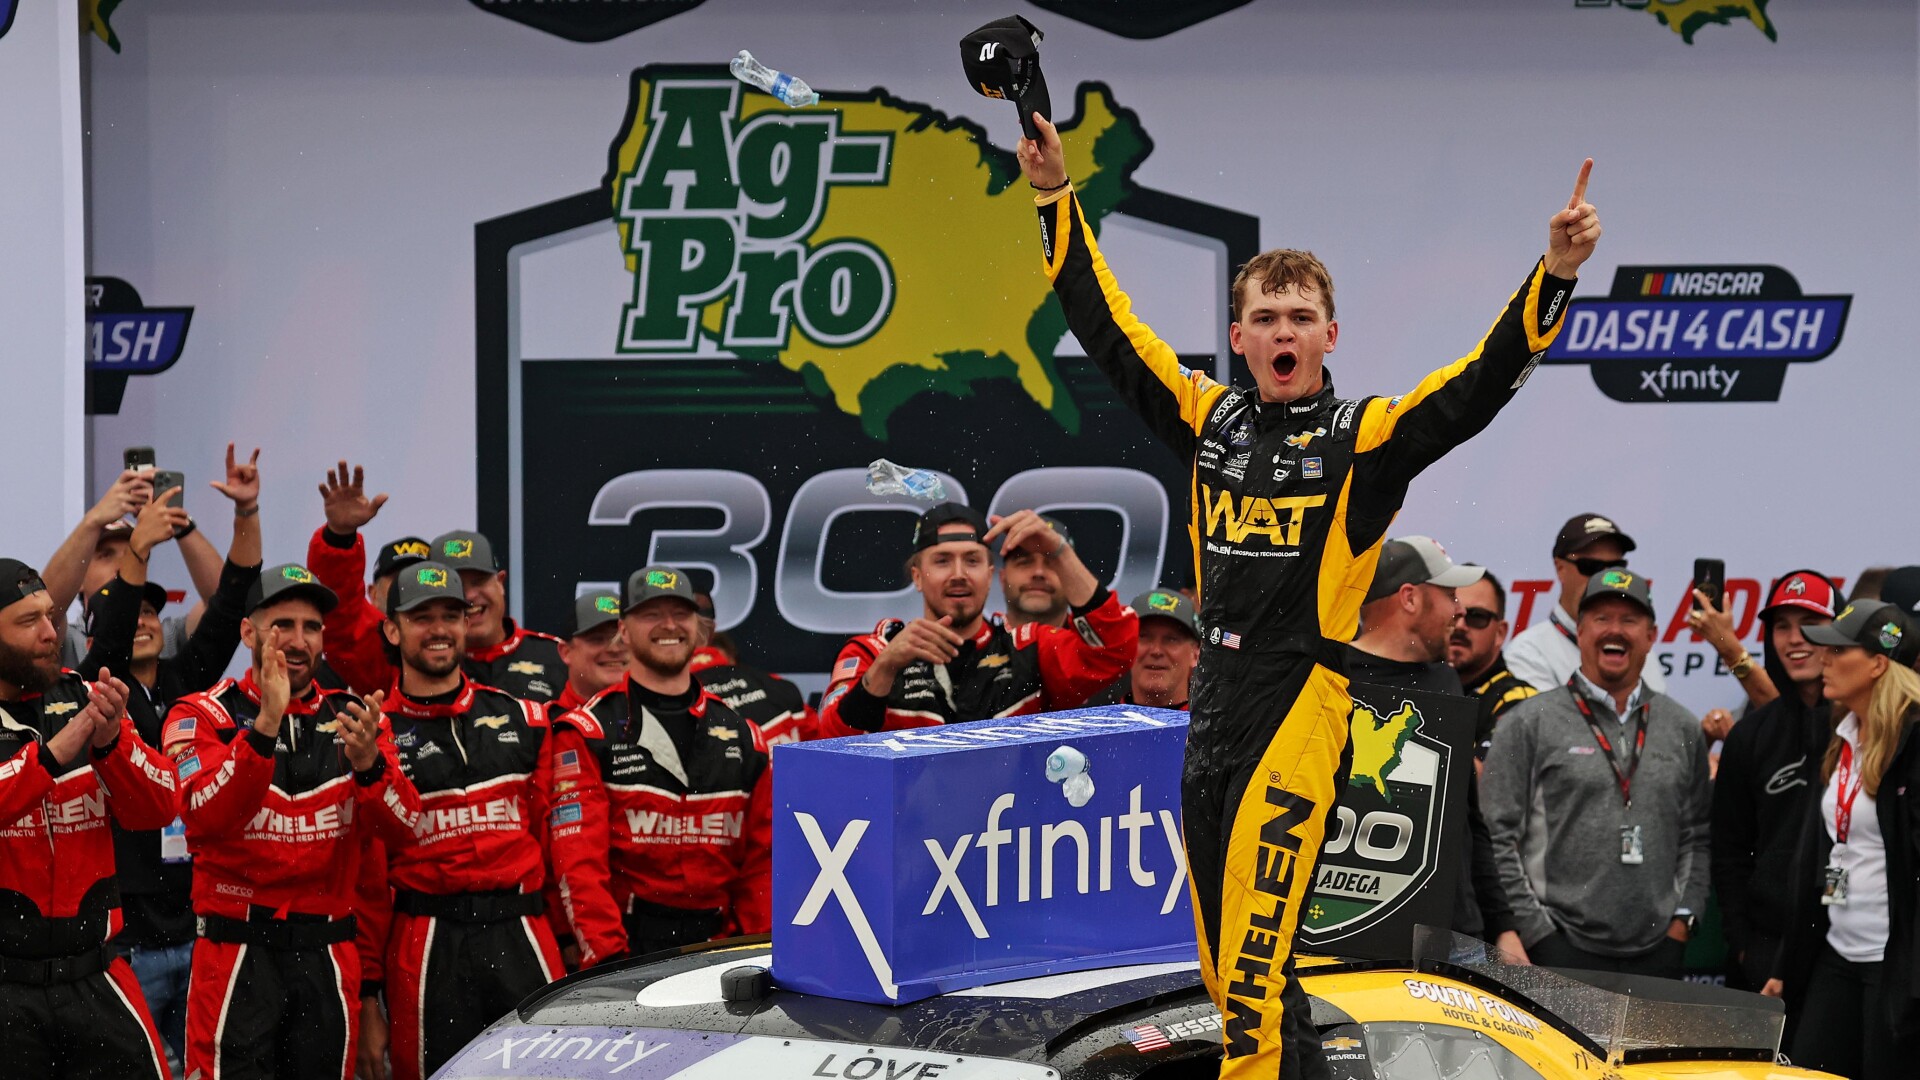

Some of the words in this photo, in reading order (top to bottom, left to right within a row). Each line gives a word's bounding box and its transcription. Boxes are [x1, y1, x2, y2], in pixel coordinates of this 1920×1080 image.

[617, 76, 897, 247] Ag-
[1040, 215, 1052, 257] sparco
[615, 214, 897, 353] Pro
[1670, 272, 1764, 296] NASCAR
[1542, 289, 1566, 326] sparco
[85, 320, 165, 363] ASH
[1566, 309, 1680, 353] DASH
[1682, 310, 1709, 352] 4
[1715, 308, 1826, 351] CASH
[1639, 363, 1740, 398] xfinity
[1201, 483, 1328, 547] WAT
[411, 794, 522, 839] WHELEN
[624, 808, 744, 839] WHELEN
[1324, 805, 1414, 862] 00
[921, 784, 1189, 939] xfinity
[1316, 869, 1381, 895] ADEGA
[1224, 785, 1316, 1061] WHELEN
[1402, 979, 1480, 1013] SOUTH
[1478, 995, 1543, 1034] POINT
[1442, 1006, 1479, 1026] HOTEL
[1481, 1017, 1492, 1028] &
[1493, 1019, 1535, 1041] CASINO
[482, 1029, 671, 1074] xfinity
